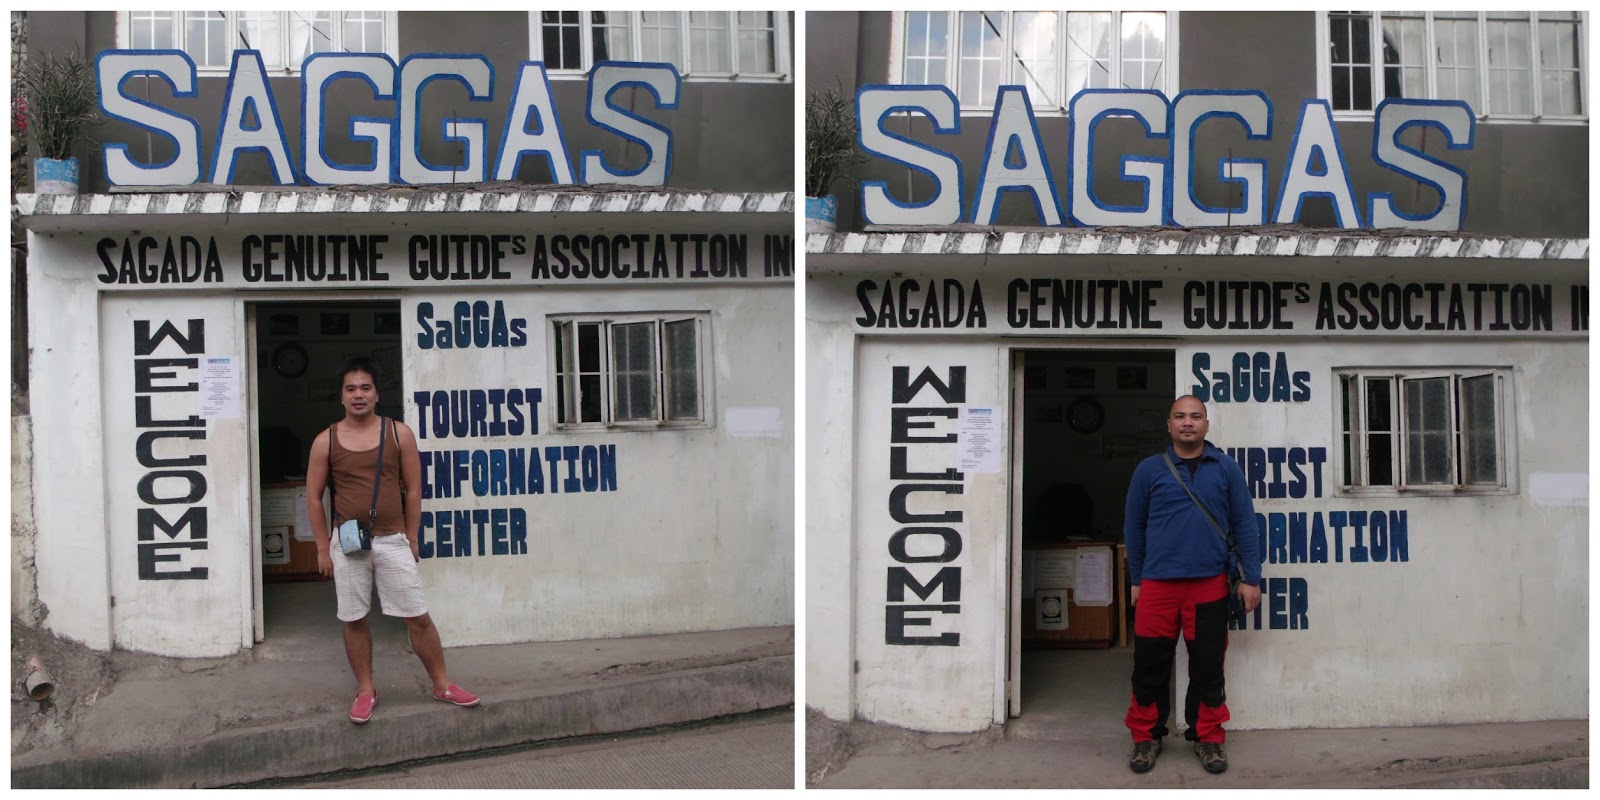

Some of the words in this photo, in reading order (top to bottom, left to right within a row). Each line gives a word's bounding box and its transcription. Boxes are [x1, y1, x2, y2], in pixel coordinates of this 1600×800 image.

[95, 49, 682, 187] SAGGAS
[856, 84, 1476, 231] SAGGAS
[96, 236, 224, 284] SAGADA
[242, 235, 389, 282] GENUINE
[531, 234, 748, 279] ASSOCIATION
[764, 234, 795, 277] IN
[855, 278, 987, 328] SAGADA
[1007, 278, 1163, 329] GENUINE
[1315, 281, 1553, 331] ASSOCIATION
[414, 388, 542, 439] TOURIST
[134, 318, 208, 580] WELCOME
[1216, 447, 1327, 499] RIST
[885, 366, 967, 646] WELCOME
[417, 508, 528, 559] CENTER
